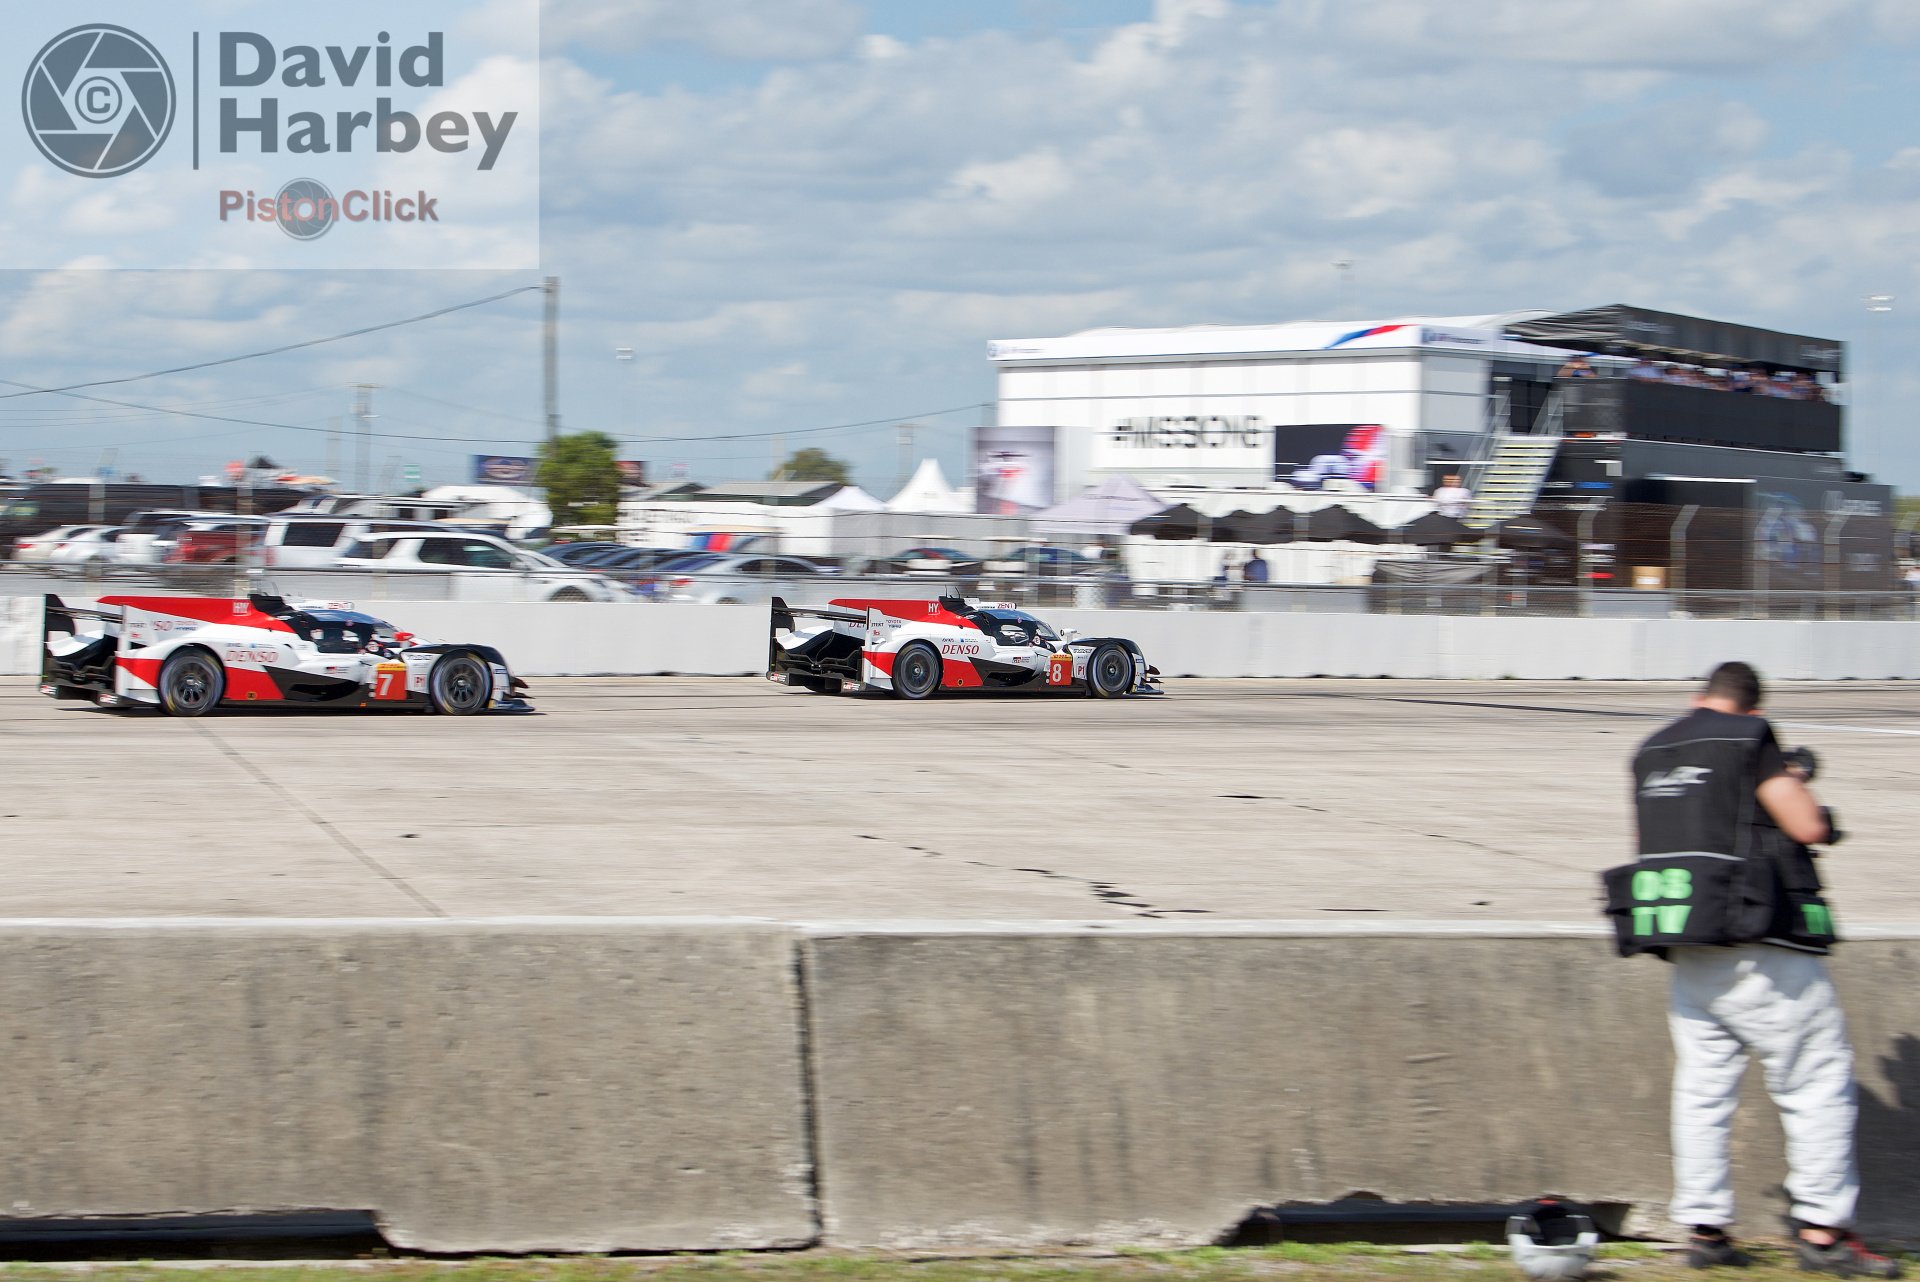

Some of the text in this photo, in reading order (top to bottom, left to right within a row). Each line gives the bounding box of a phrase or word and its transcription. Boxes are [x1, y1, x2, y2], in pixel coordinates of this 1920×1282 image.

[928, 602, 939, 613] HY
[942, 644, 980, 655] DENSO
[224, 650, 280, 663] DENSO
[1052, 663, 1062, 683] 8
[378, 673, 395, 696] 7
